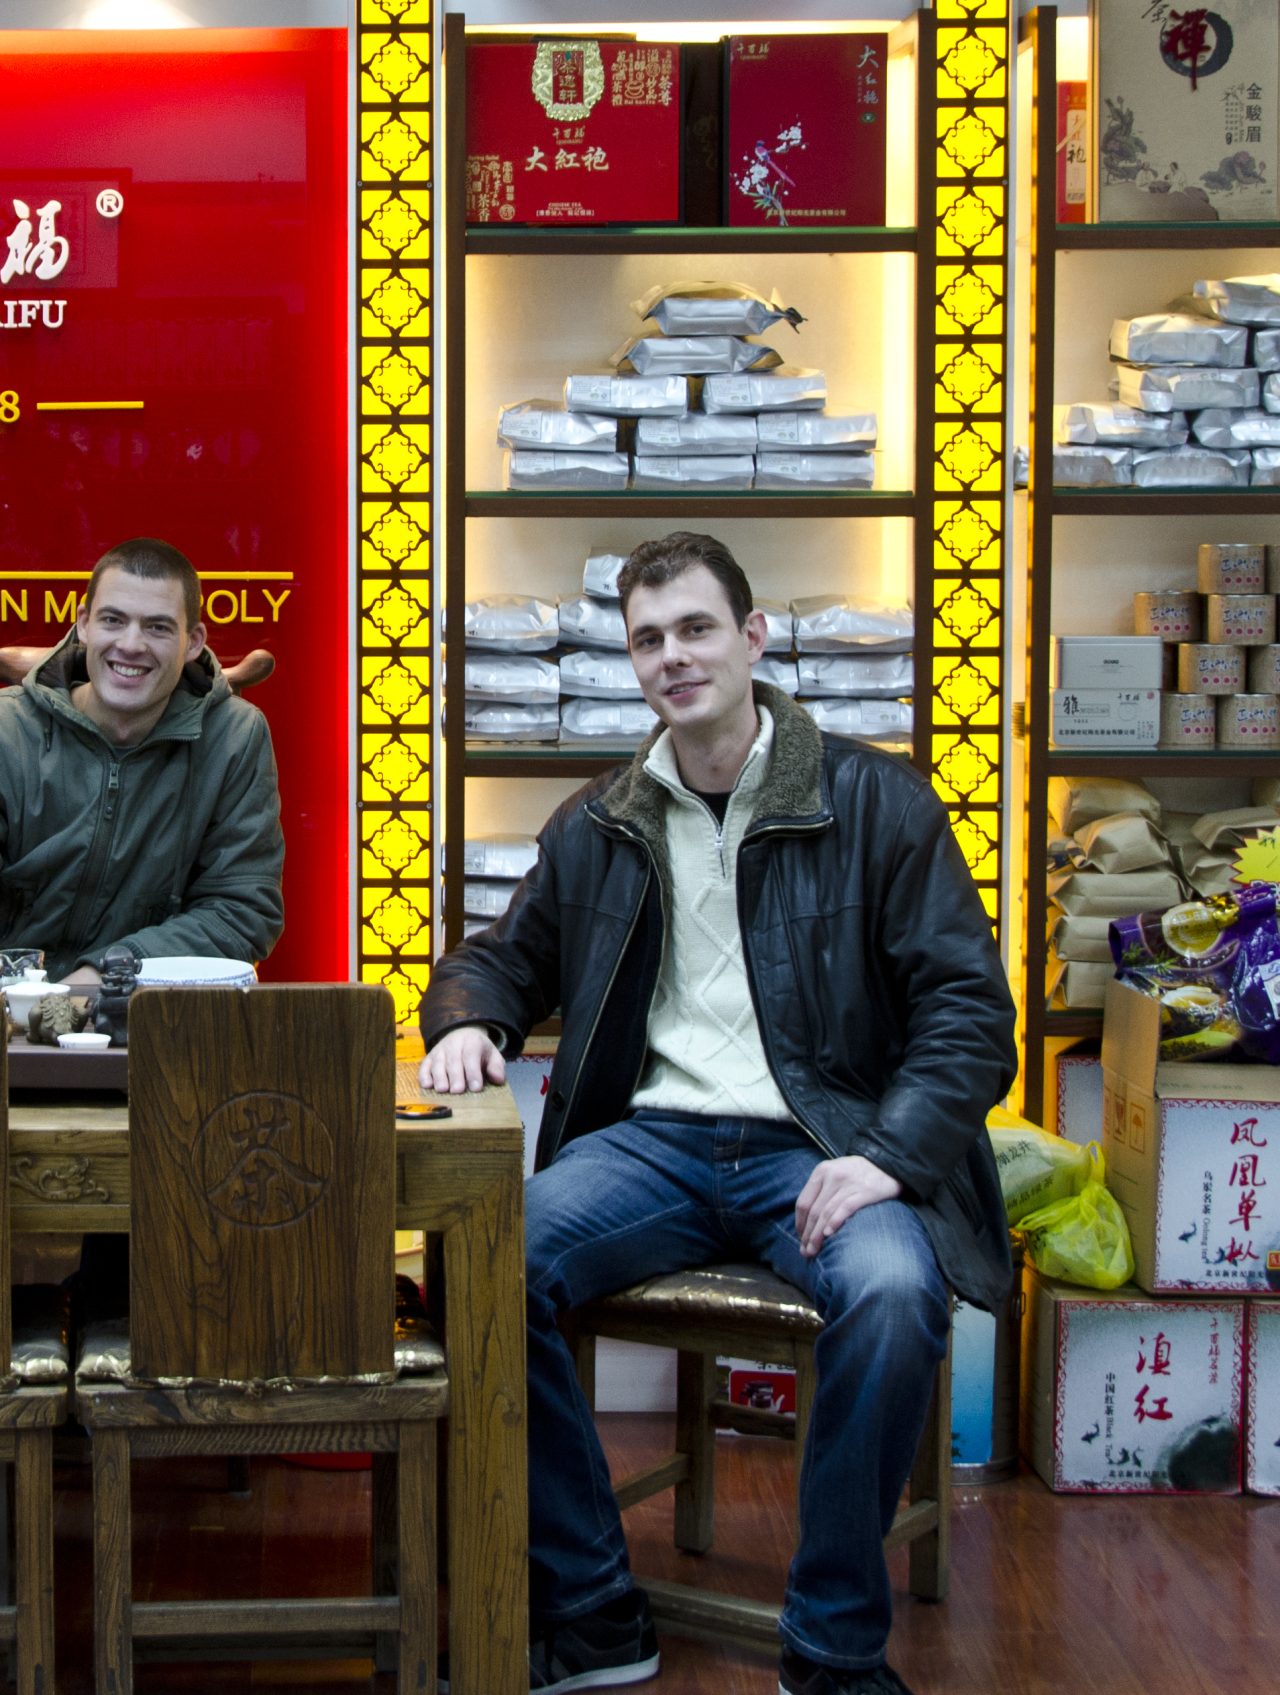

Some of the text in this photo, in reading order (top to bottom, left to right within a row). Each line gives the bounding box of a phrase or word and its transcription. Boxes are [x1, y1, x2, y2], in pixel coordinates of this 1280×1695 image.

[1245, 82, 1263, 143] 金駿眉
[524, 145, 610, 173] 大紅袍
[44, 588, 292, 623] MOLY
[1104, 1371, 1116, 1416] 中国红茶
[1133, 1331, 1174, 1425] 滇红
